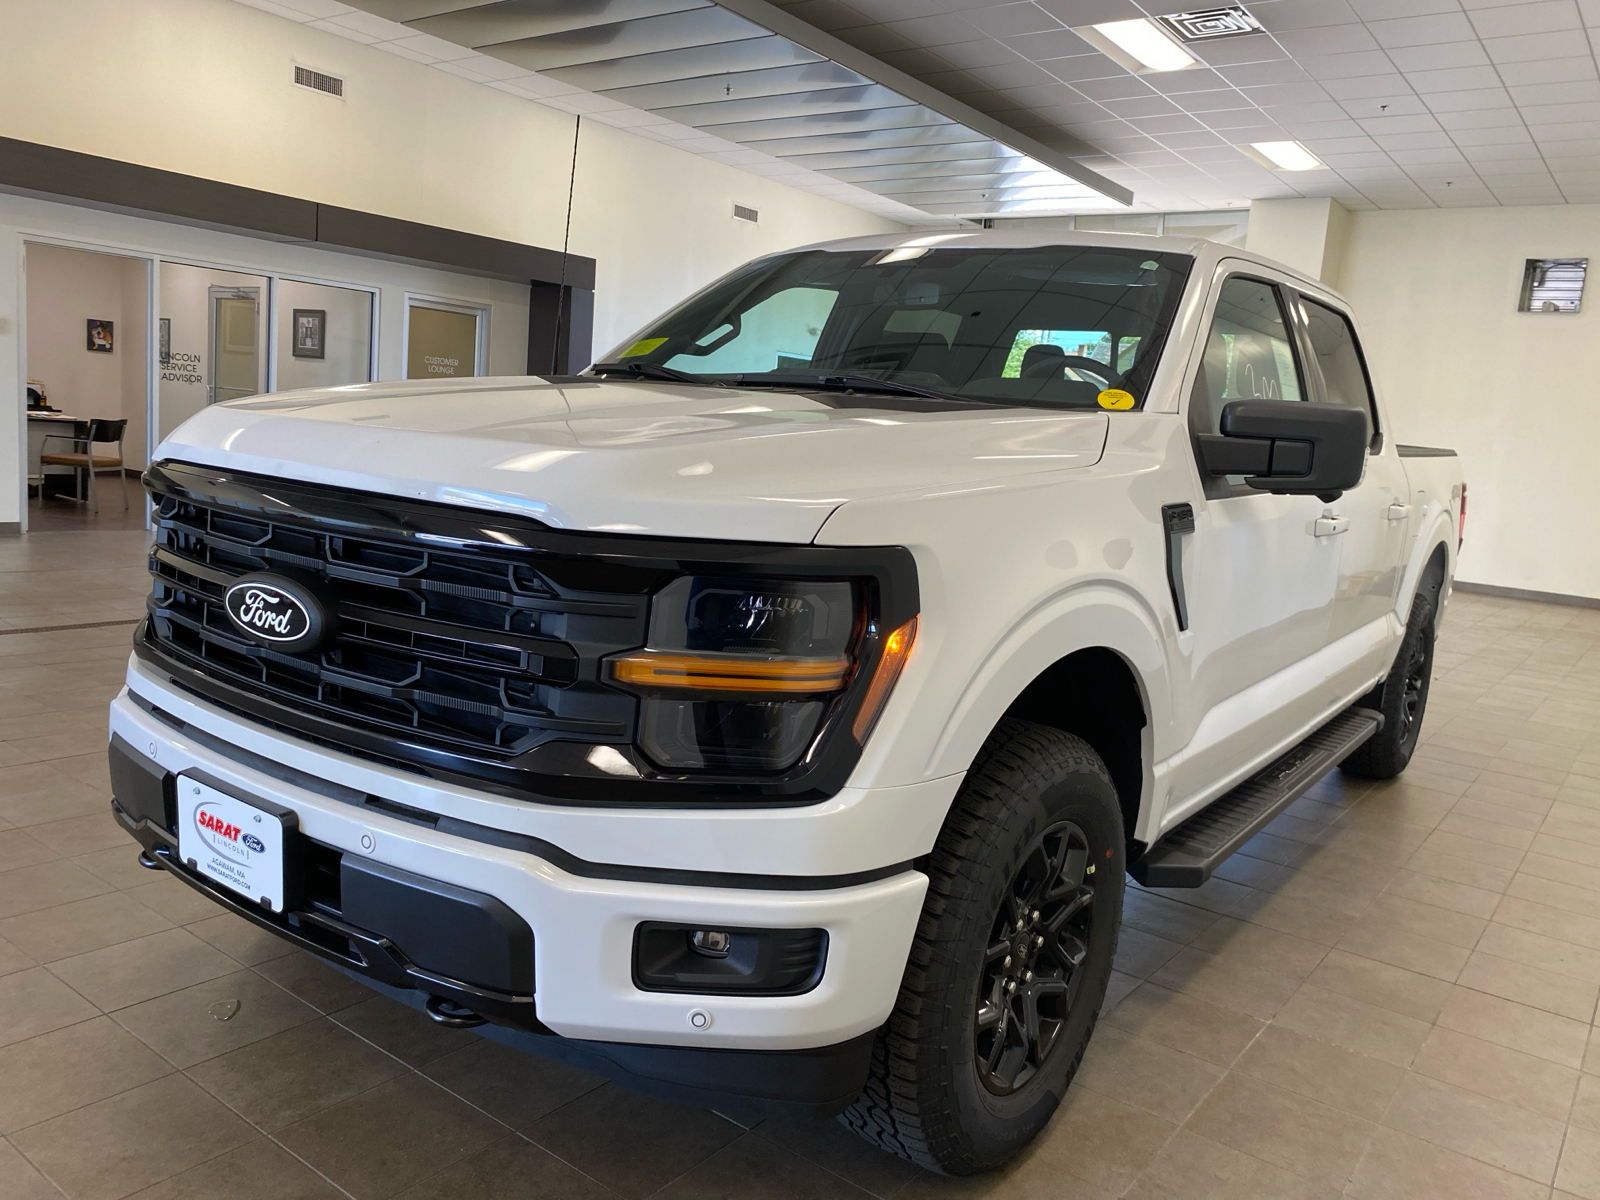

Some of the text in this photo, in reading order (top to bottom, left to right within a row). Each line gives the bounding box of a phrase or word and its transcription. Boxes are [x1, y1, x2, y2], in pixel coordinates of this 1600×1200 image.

[161, 362, 197, 373] SERVICE
[424, 355, 459, 366] CUSTOMER
[161, 373, 203, 383] ADVISOR
[428, 365, 455, 374] LOUNGE
[240, 589, 293, 634] Ford
[198, 810, 242, 843] SARAT
[217, 838, 245, 856] LINCOLN
[245, 836, 262, 852] Ford
[207, 862, 251, 890] WWW.SARATFORD.COM
[212, 857, 246, 879] AGAWAM, MA
